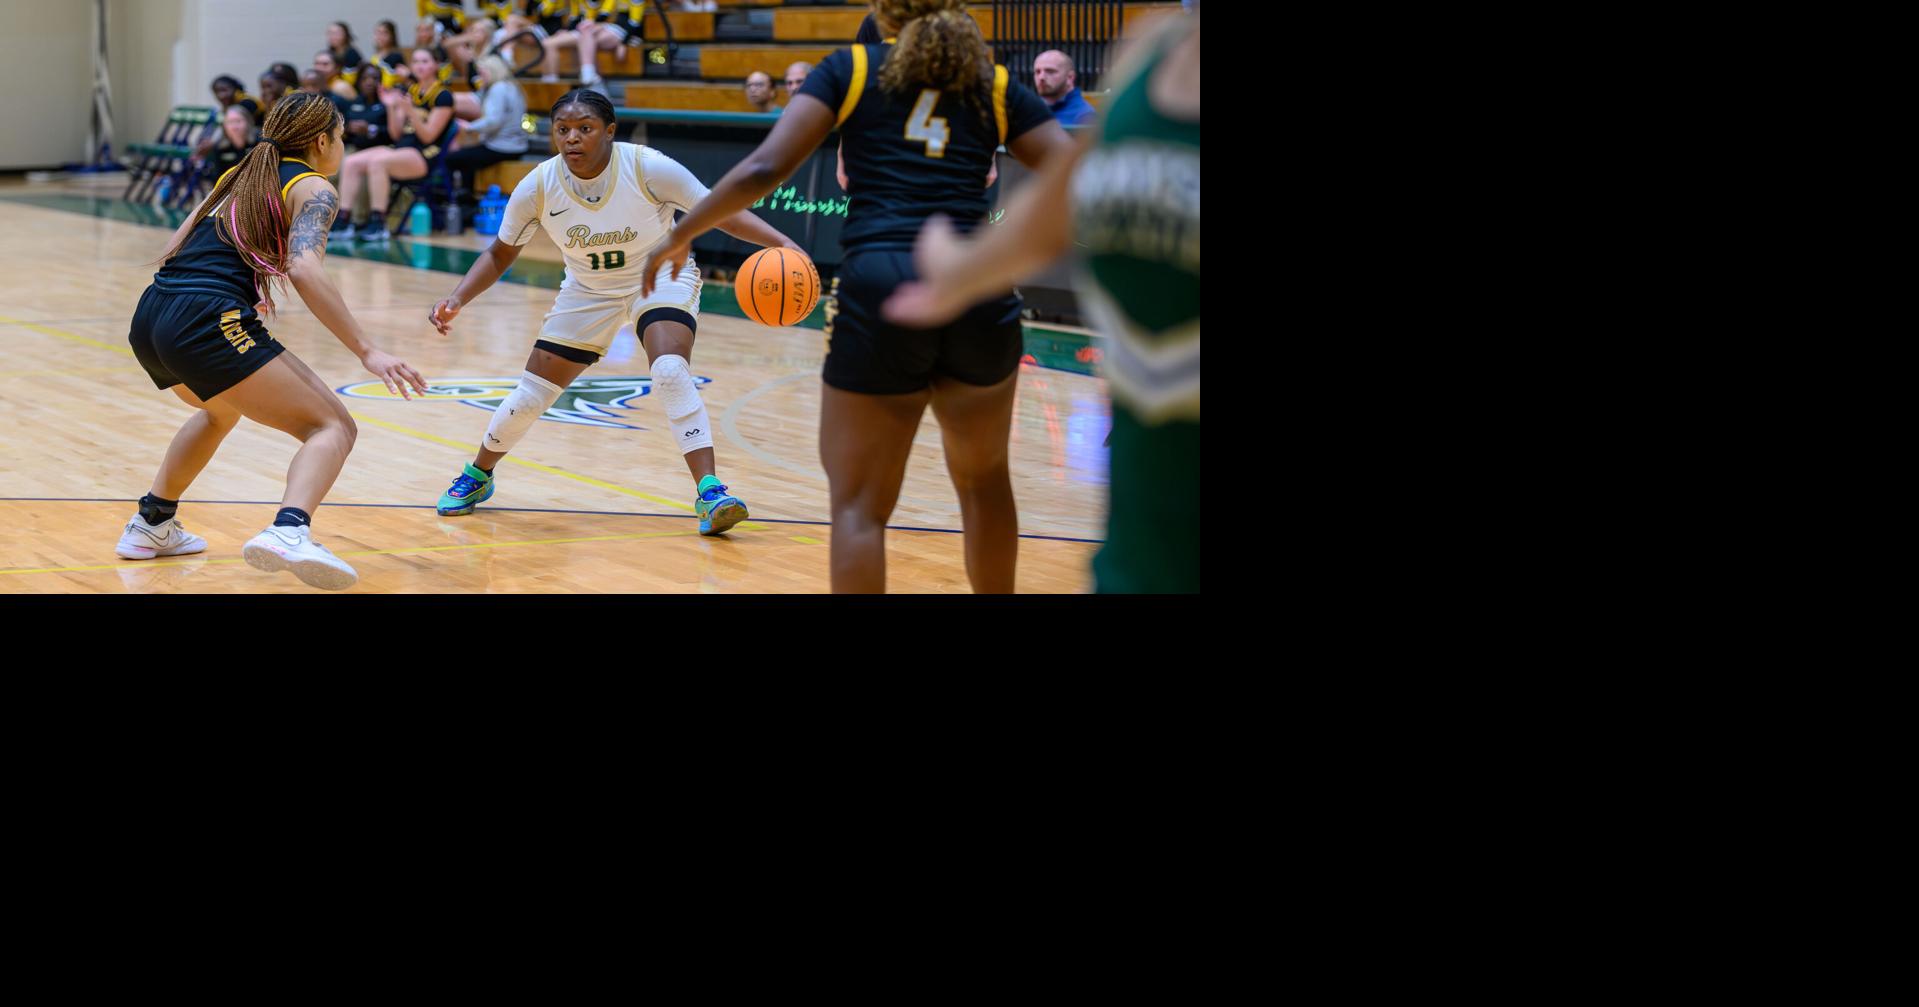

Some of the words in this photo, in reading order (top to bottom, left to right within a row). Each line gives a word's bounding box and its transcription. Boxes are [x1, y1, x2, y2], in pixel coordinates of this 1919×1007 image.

[905, 89, 951, 157] 4
[564, 224, 638, 249] Rams
[587, 251, 625, 270] 10
